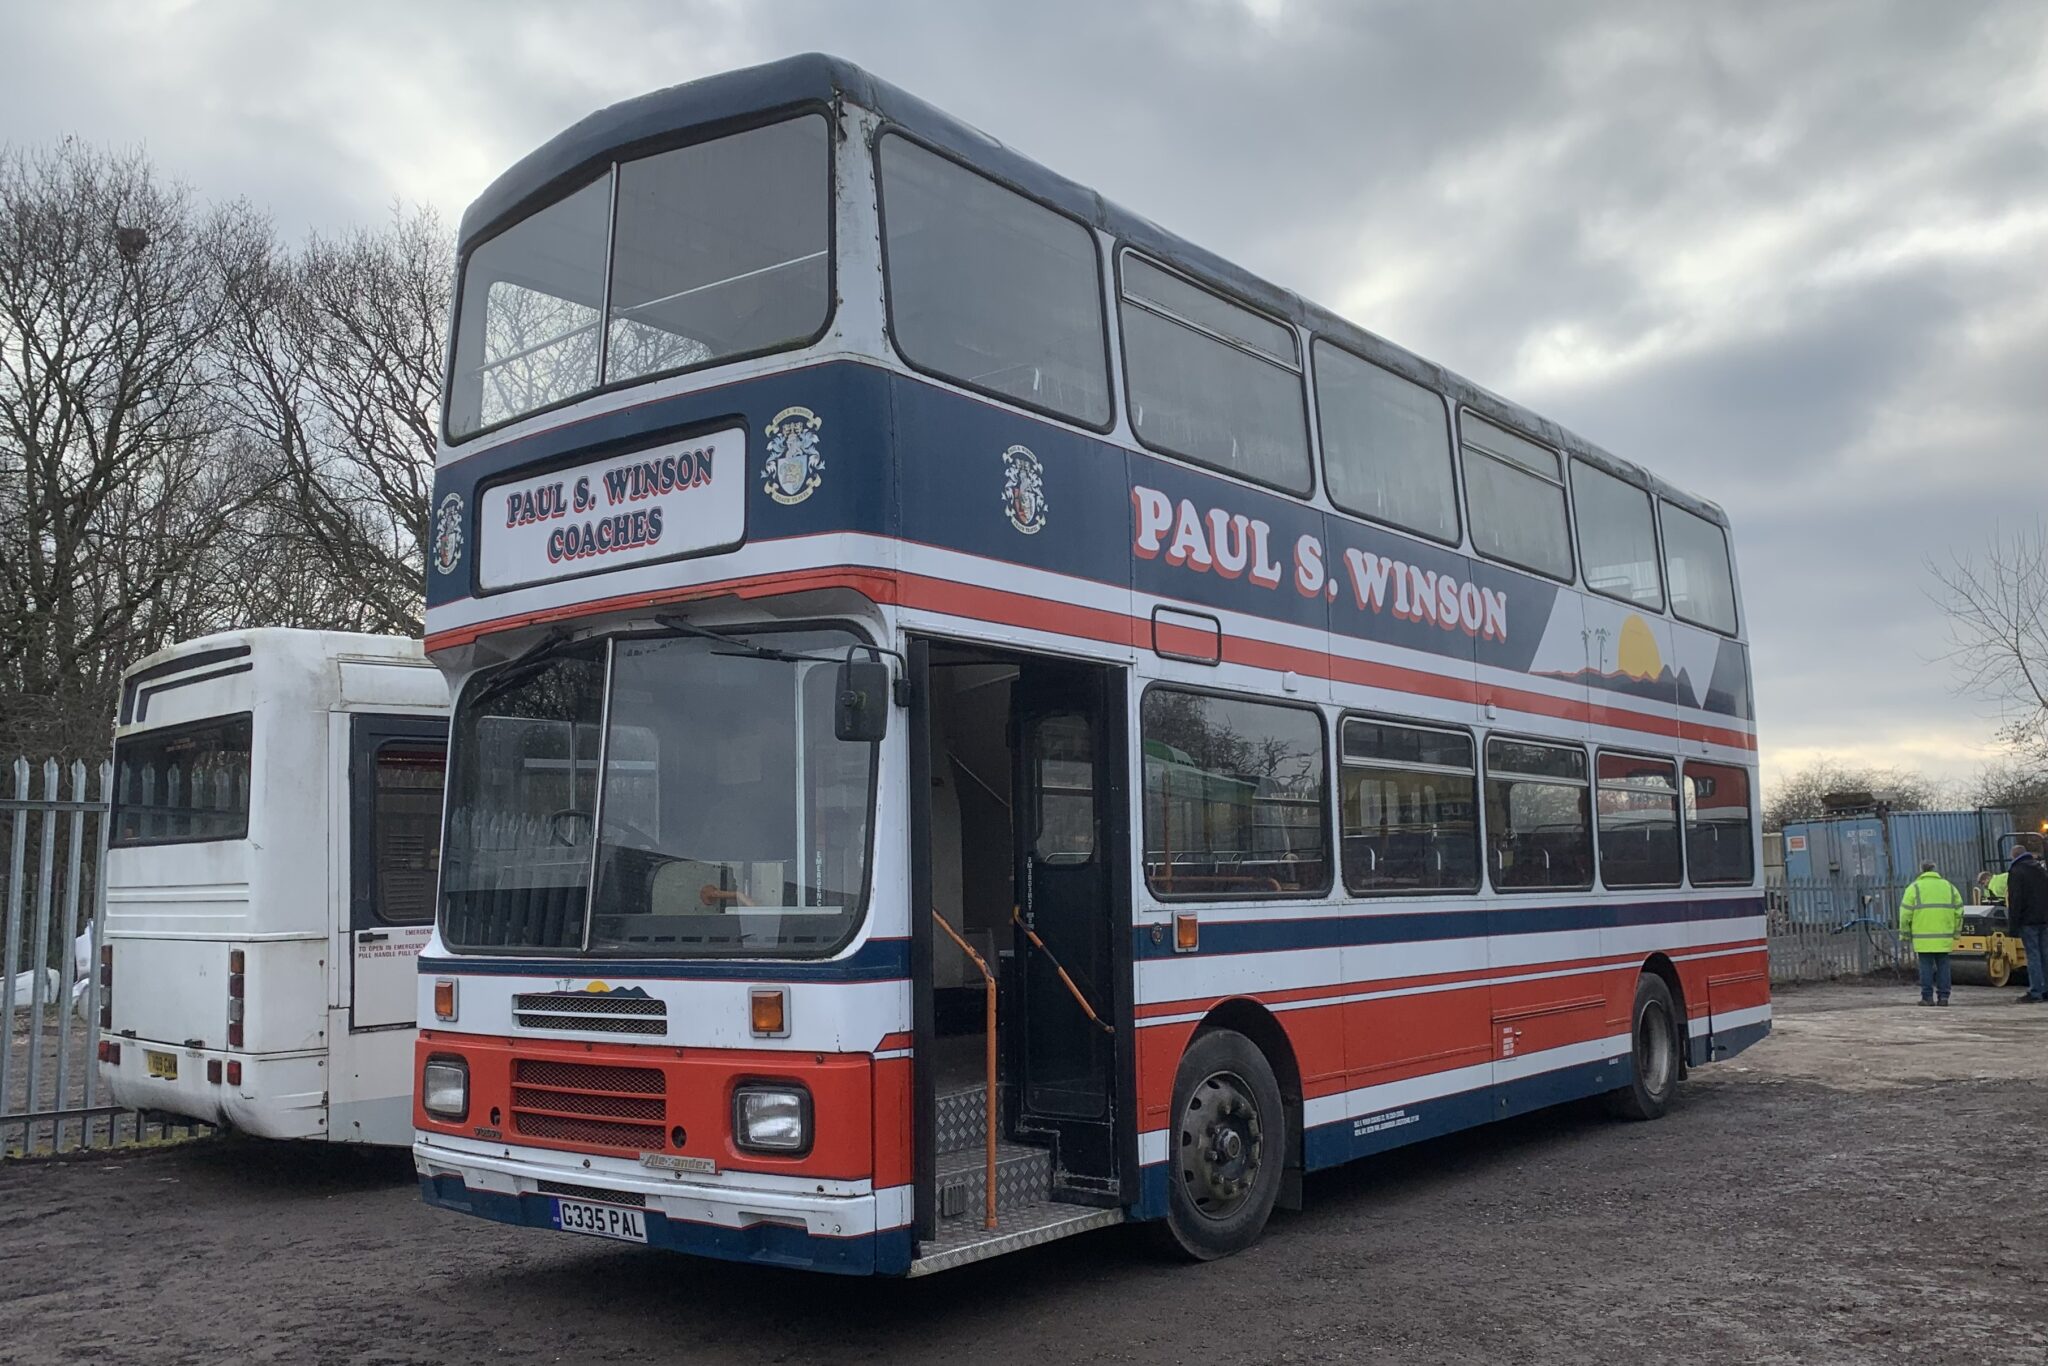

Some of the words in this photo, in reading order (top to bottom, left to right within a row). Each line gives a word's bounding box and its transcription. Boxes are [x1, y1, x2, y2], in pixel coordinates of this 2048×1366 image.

[506, 483, 566, 529] PAUL
[573, 477, 597, 513] S.
[603, 446, 716, 505] WINSON
[547, 507, 664, 564] COACHES
[1132, 485, 1282, 591] PAUL
[1294, 534, 1339, 603] S.
[1344, 547, 1508, 644] WINSON
[405, 928, 433, 936] EMERGENC
[645, 1154, 711, 1170] Alexander
[562, 1203, 606, 1231] G335
[608, 1209, 644, 1238] PAL
